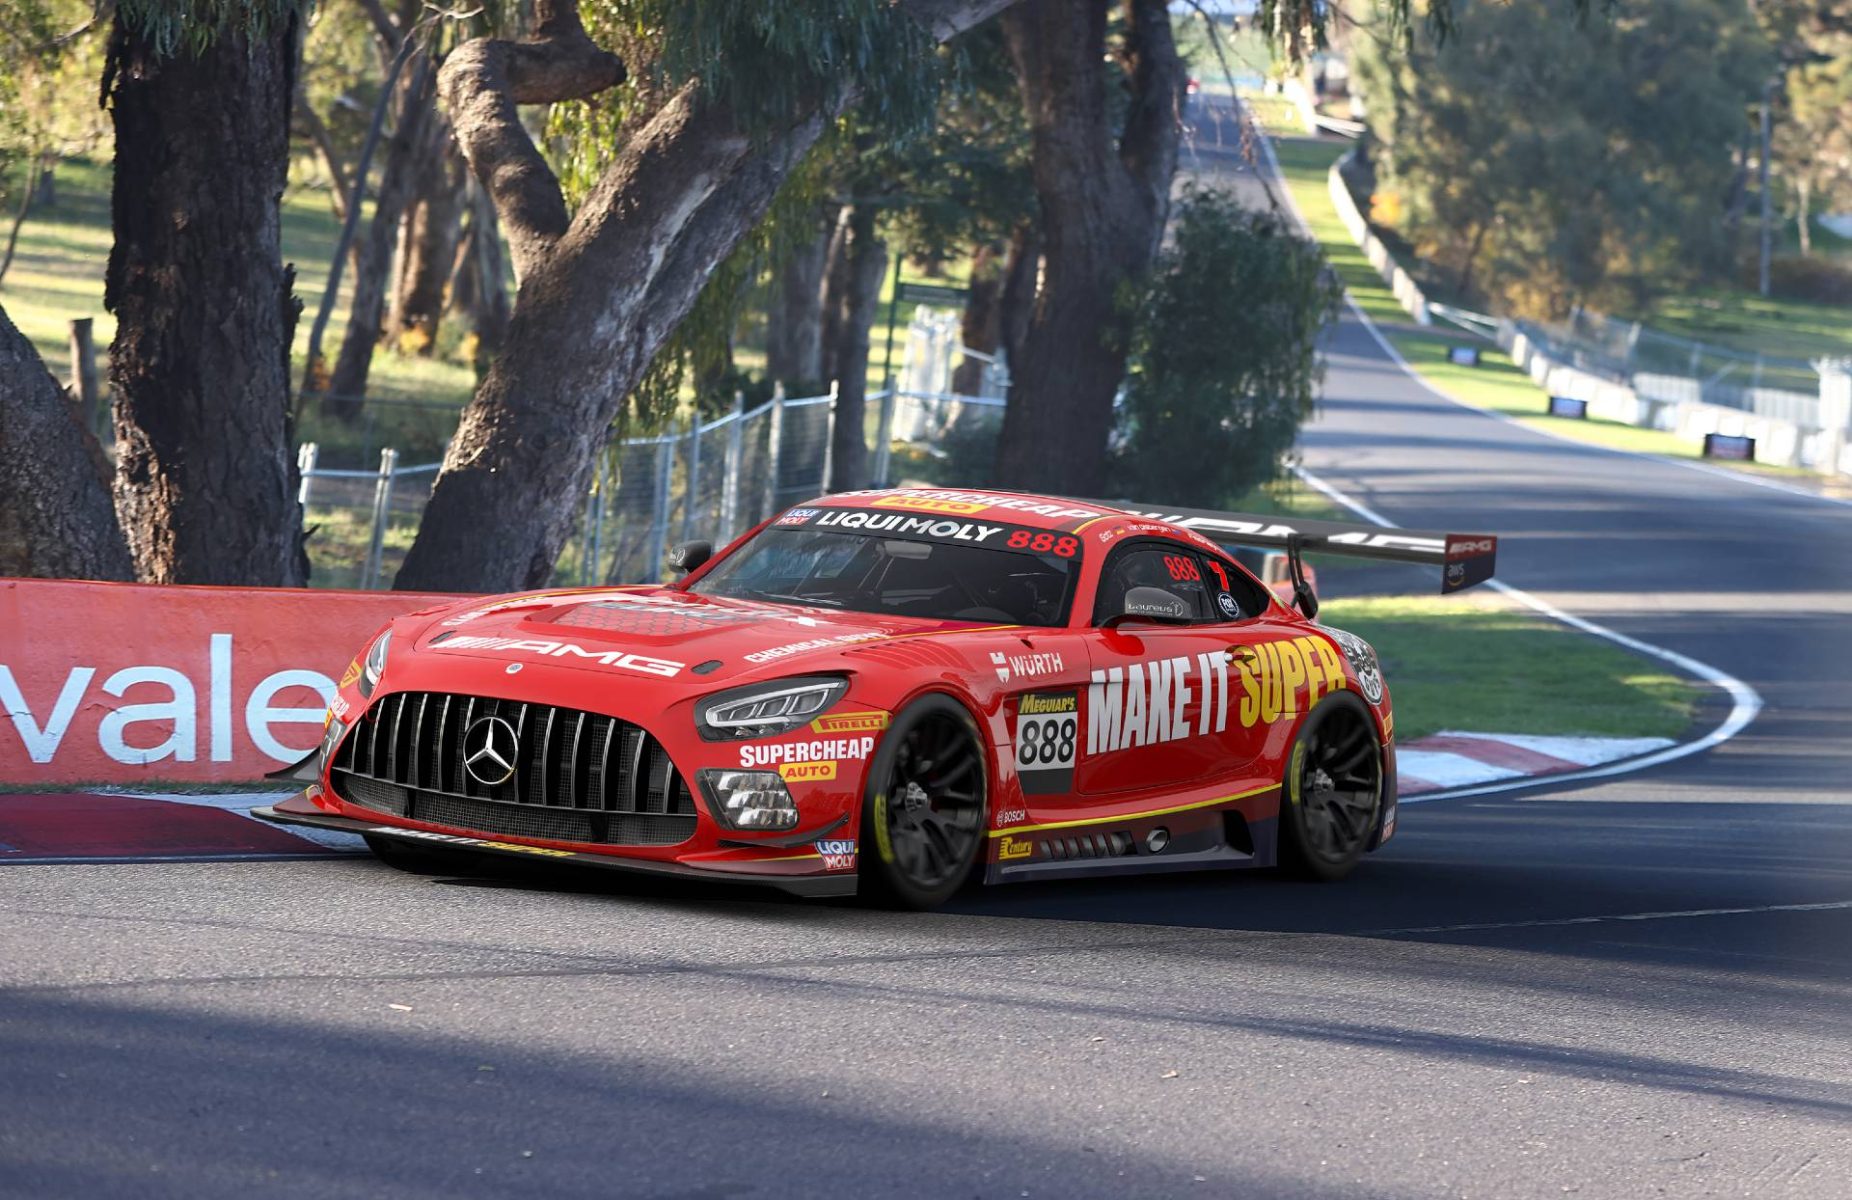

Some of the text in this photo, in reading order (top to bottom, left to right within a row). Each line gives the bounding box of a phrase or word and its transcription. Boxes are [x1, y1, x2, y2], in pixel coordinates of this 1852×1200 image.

[886, 498, 972, 511] AUTO
[816, 511, 1003, 542] LIQUI MOLY
[1007, 530, 1079, 558] 888
[1164, 556, 1200, 581] 888
[500, 639, 686, 678] AMG
[1009, 653, 1064, 677] WÜRTH
[0, 633, 338, 764] vale
[1087, 635, 1346, 755] MAKE IT SUPER
[817, 715, 883, 731] PIRELLI
[740, 737, 874, 768] SUPERCHEAP
[1018, 718, 1076, 766] 888
[785, 765, 831, 778] AUTO
[1004, 810, 1025, 824] BOSCH
[817, 841, 854, 854] LIQUI
[825, 855, 854, 868] MOLY
